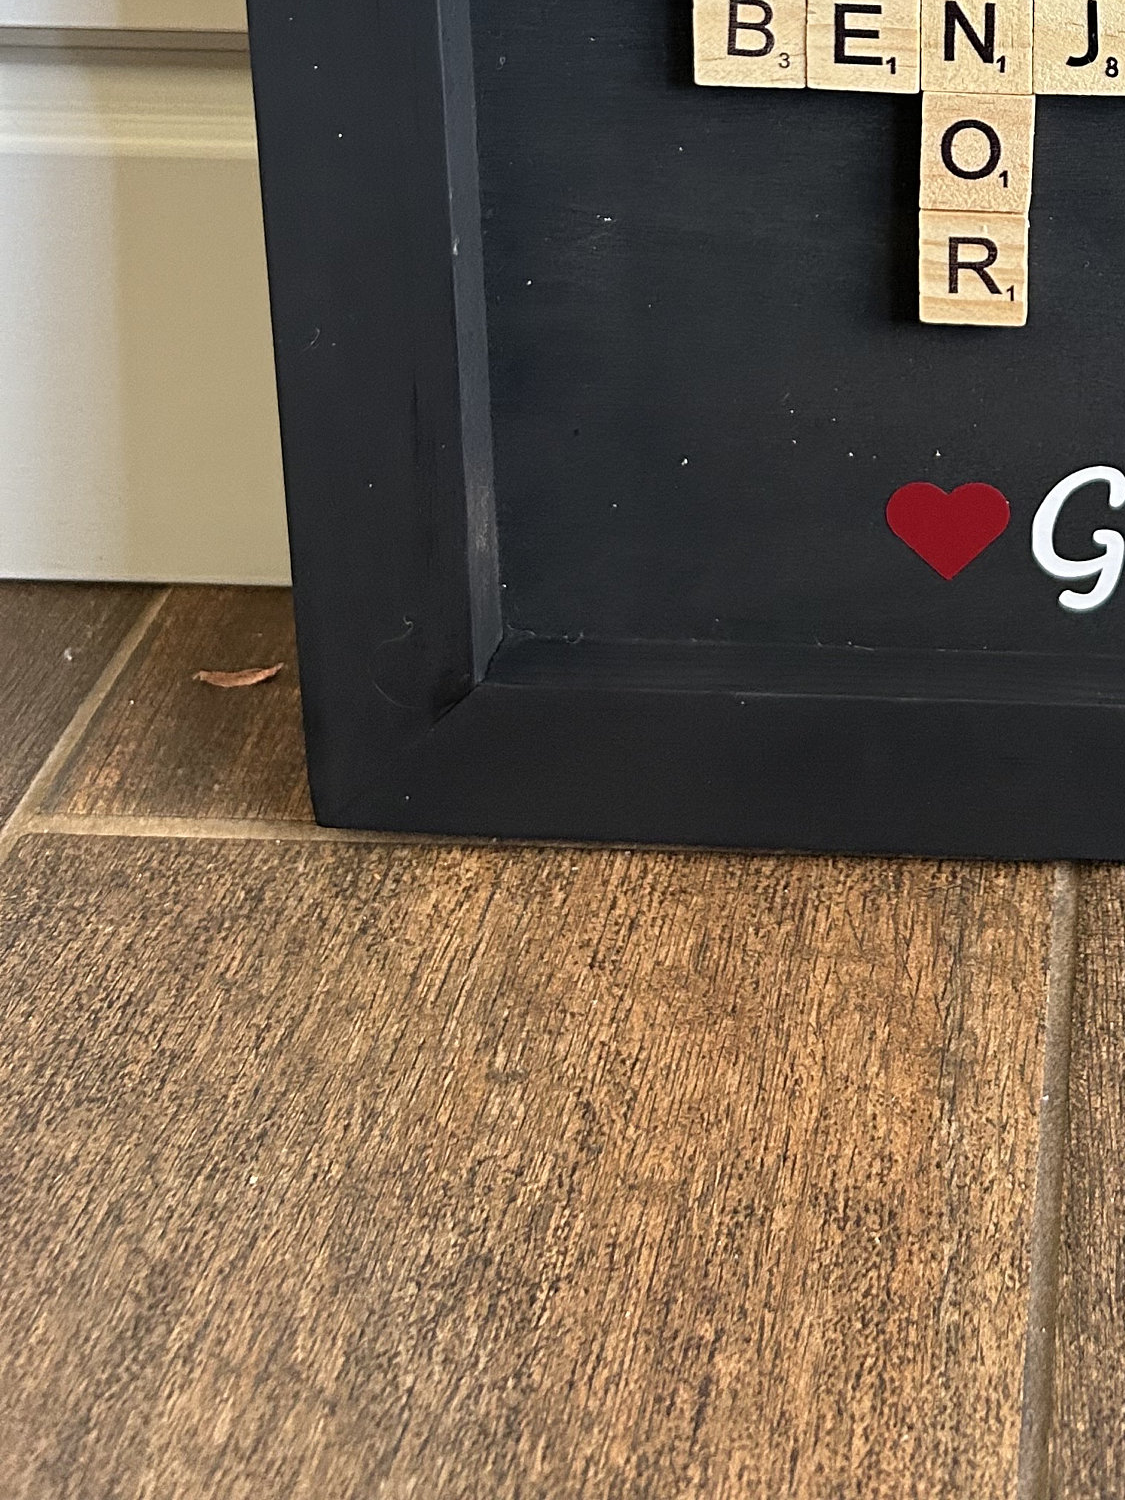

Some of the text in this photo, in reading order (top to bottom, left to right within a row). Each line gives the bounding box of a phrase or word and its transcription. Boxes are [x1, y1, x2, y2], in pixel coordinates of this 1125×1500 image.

[778, 52, 792, 69] 3
[885, 56, 897, 75] 1
[996, 55, 1007, 74] 1
[1104, 56, 1120, 79] 8
[998, 170, 1010, 188] 1
[1006, 285, 1016, 302] 1
